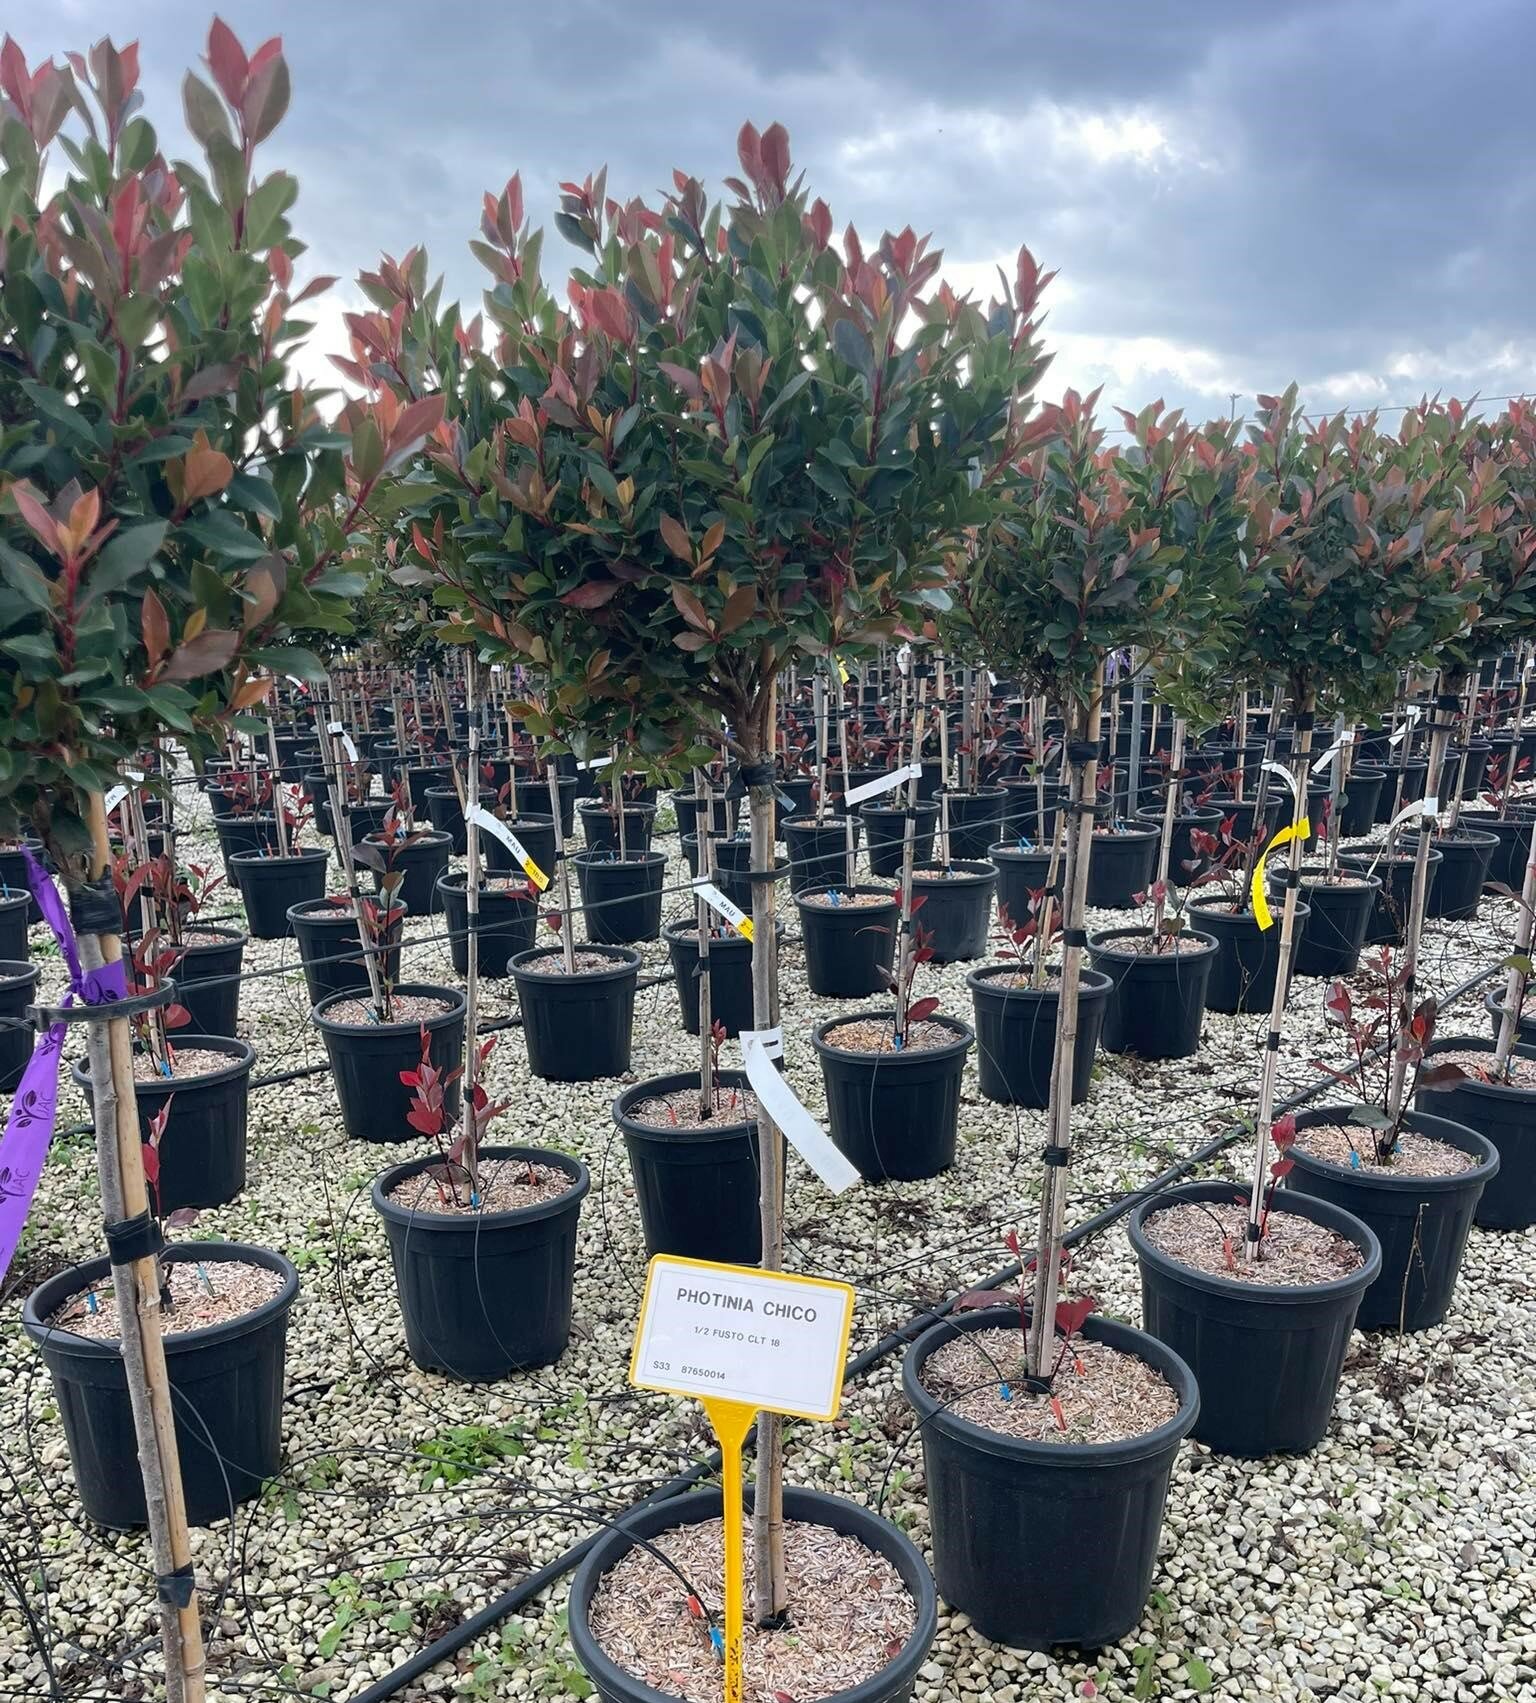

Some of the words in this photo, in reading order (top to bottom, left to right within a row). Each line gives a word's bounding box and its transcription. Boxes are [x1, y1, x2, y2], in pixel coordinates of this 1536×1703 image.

[719, 901, 736, 917] MAU
[676, 1287, 754, 1313] PHOTINIA
[762, 1301, 817, 1323] CHICO
[694, 1326, 710, 1336] 1/2
[712, 1328, 744, 1342] FUSTO
[747, 1334, 767, 1345] CLT
[770, 1338, 781, 1348] 18
[652, 1360, 671, 1371] S33
[681, 1365, 726, 1380] 87650014
